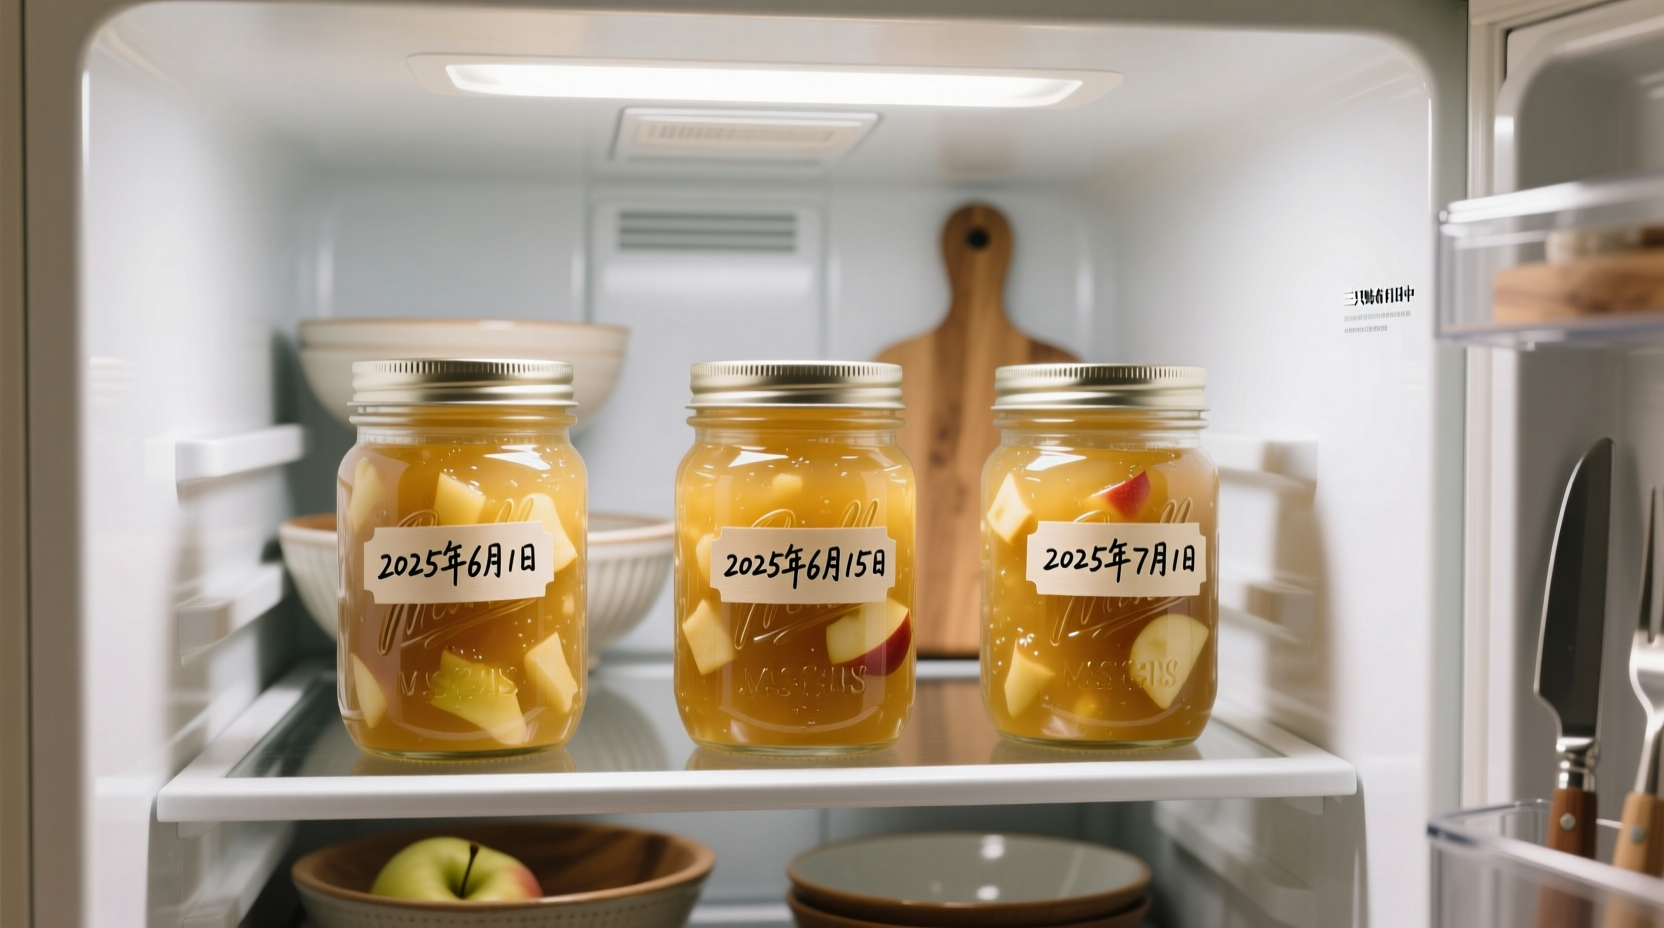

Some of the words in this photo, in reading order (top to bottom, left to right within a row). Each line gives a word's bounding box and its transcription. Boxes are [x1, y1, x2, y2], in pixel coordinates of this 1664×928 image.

[378, 540, 536, 587] 2025年6月1日
[723, 543, 885, 589] 2025年6月15日
[1043, 538, 1195, 584] 2025年7月1日
